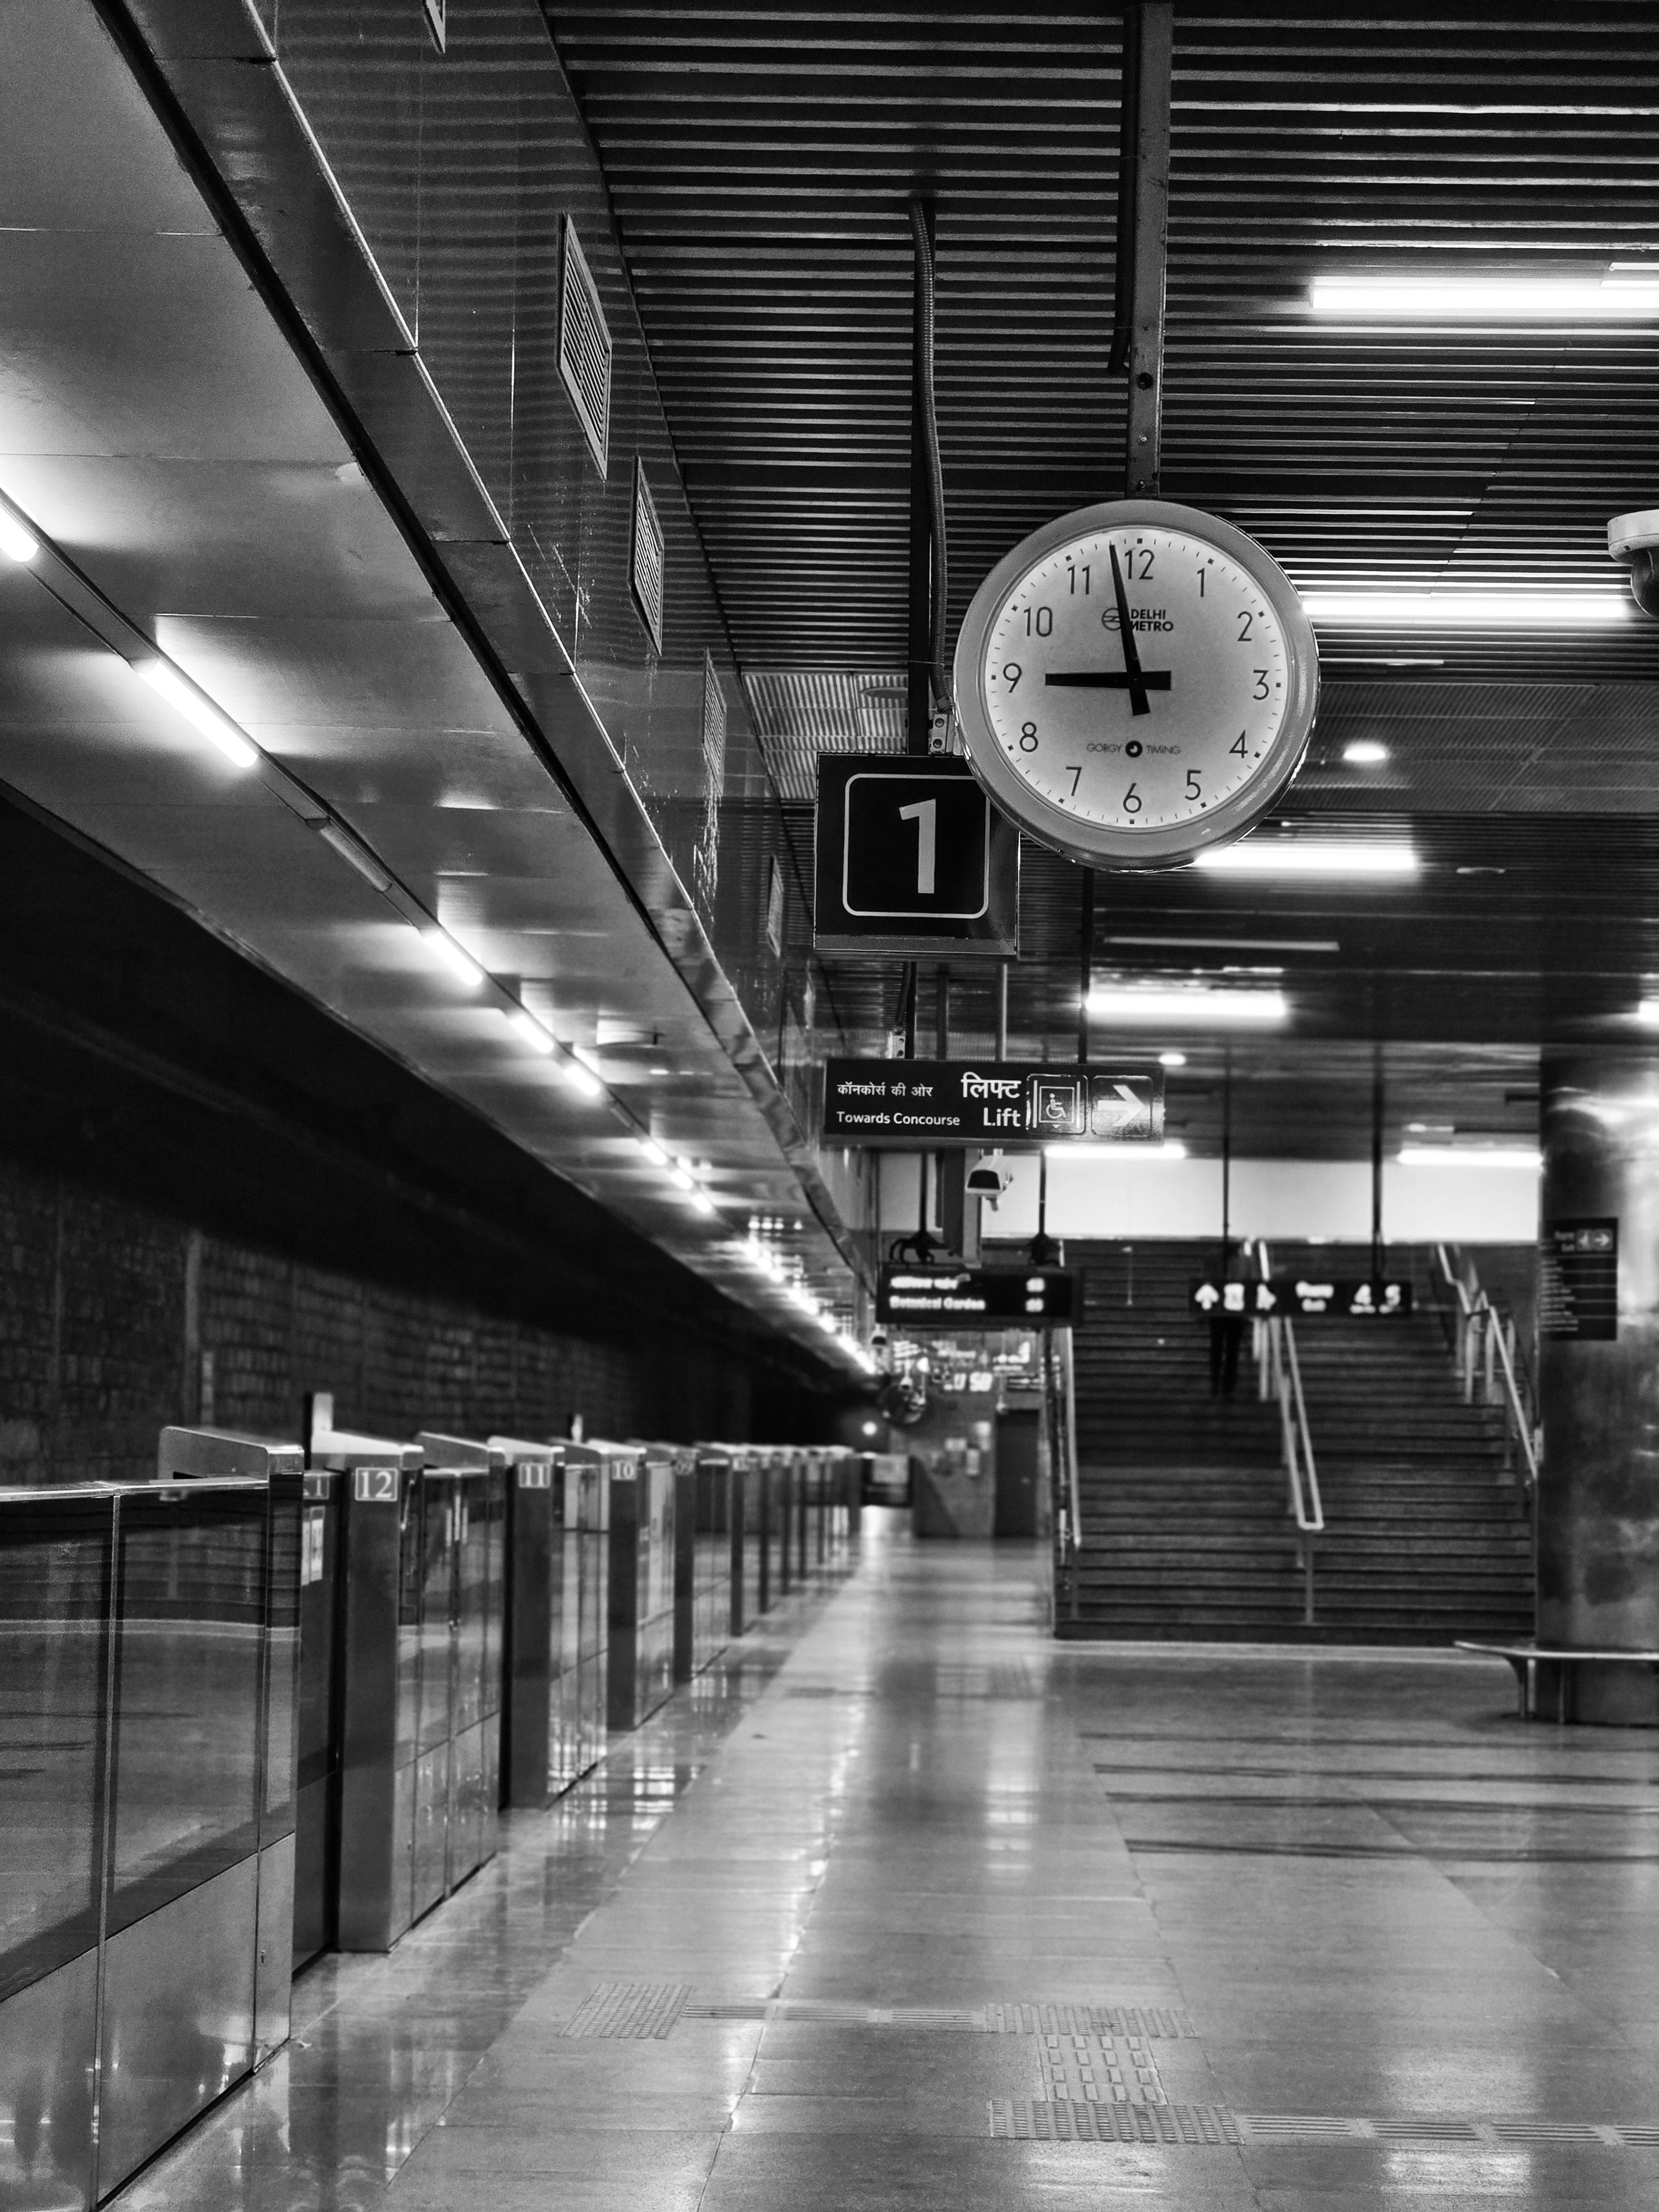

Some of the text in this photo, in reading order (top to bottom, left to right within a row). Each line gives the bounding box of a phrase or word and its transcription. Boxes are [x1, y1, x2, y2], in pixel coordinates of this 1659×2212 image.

[1067, 564, 1091, 595] 11
[1124, 549, 1155, 580] 12
[1197, 567, 1205, 598] 1
[1024, 606, 1053, 638] 10
[1130, 609, 1166, 619] DELHI
[1237, 611, 1253, 642] 2
[1003, 662, 1023, 693] 9
[1253, 669, 1269, 701] 3
[1019, 721, 1039, 753] 8
[1087, 743, 1181, 754] GORGY TIMING
[1229, 729, 1248, 759] 4
[1066, 766, 1083, 796] 7
[1185, 769, 1202, 801] 5
[1123, 782, 1142, 813] 6
[899, 799, 936, 894] 1
[837, 1081, 933, 1097] कॉनकोर्स की ओर
[960, 1071, 1022, 1099] लिफ्ट
[836, 1111, 961, 1126] Towards Concourse
[983, 1107, 1021, 1127] Lift
[362, 1471, 392, 1498] 12
[525, 1465, 545, 1486] 11
[614, 1463, 634, 1479] 10
